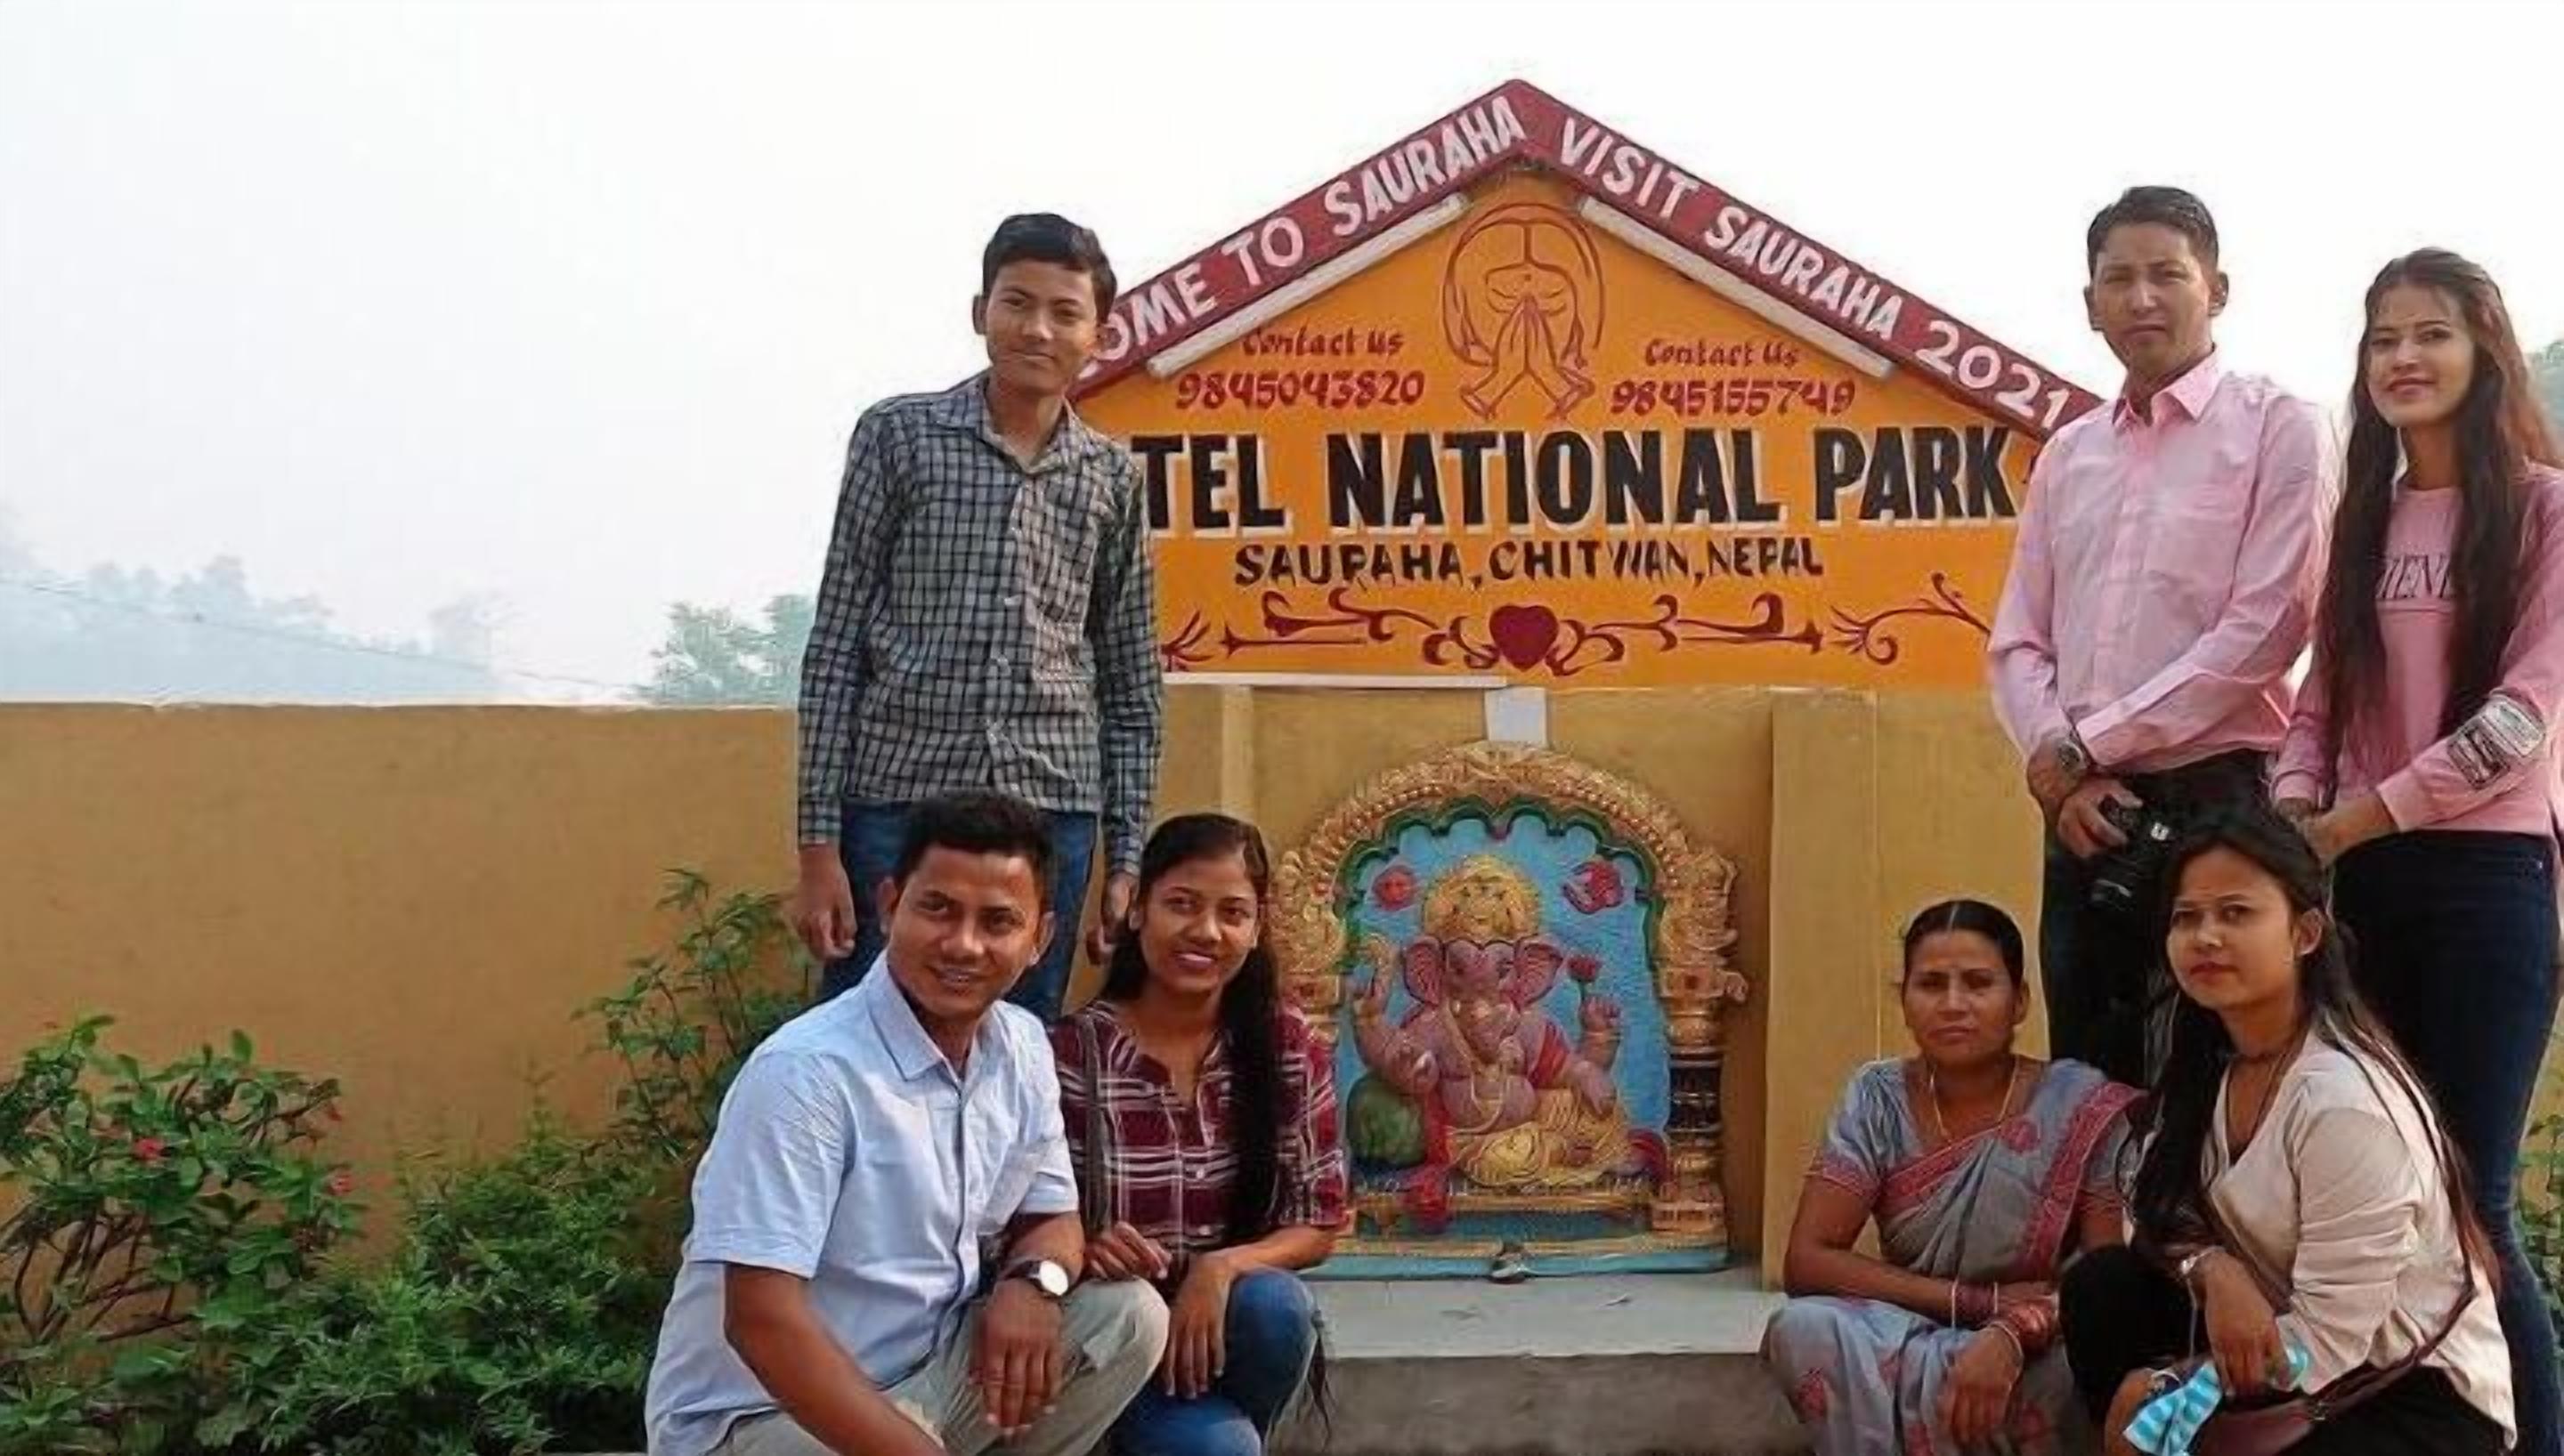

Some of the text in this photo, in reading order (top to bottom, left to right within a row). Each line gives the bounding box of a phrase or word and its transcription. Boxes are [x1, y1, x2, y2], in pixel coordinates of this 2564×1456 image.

[1078, 96, 1526, 380] OME TO SAURAHA
[1559, 117, 2071, 427] VISIT SAURAHA 2021
[1242, 326, 1356, 356] Contact
[1645, 338, 1754, 367] Contact
[1175, 370, 1424, 410] 9845043820
[1610, 378, 1855, 417] 9845155749
[1129, 426, 2016, 531] TEL NATIONAL PARK
[1706, 536, 1825, 578] NEPAL
